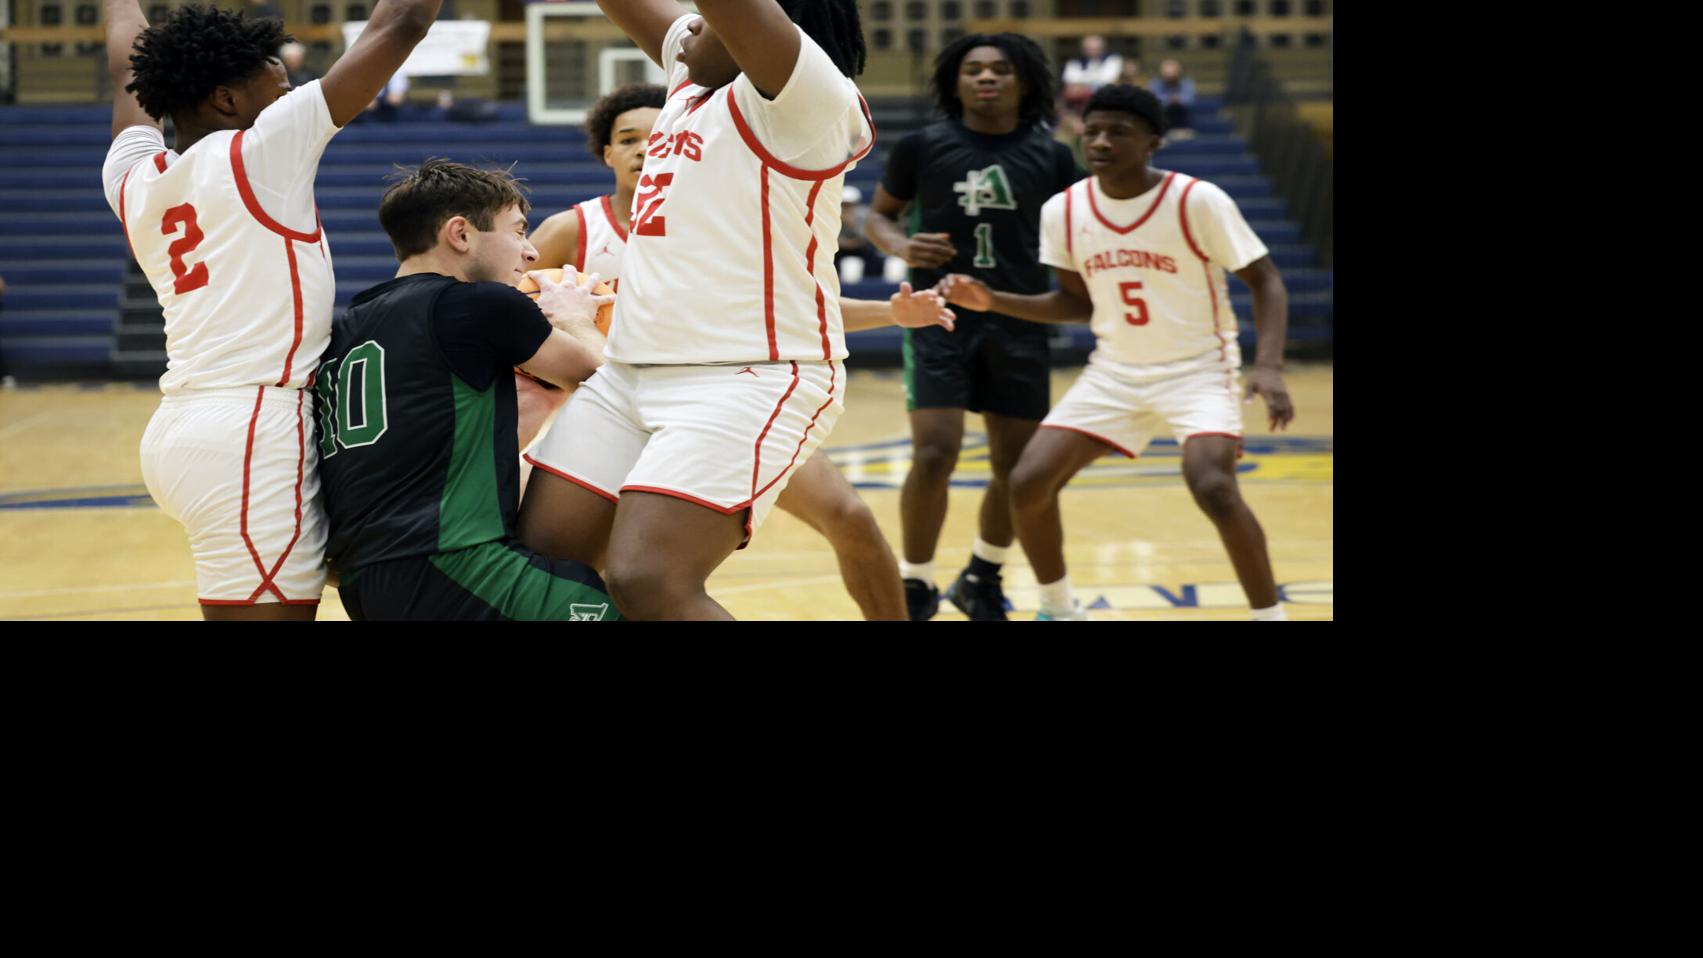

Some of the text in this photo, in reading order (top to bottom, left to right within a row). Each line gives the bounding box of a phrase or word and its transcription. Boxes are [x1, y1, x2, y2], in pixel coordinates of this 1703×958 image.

[161, 202, 209, 295] 2
[973, 223, 996, 268] 1
[1084, 249, 1178, 278] FALCONS
[1119, 282, 1149, 326] 5
[317, 340, 388, 459] 10
